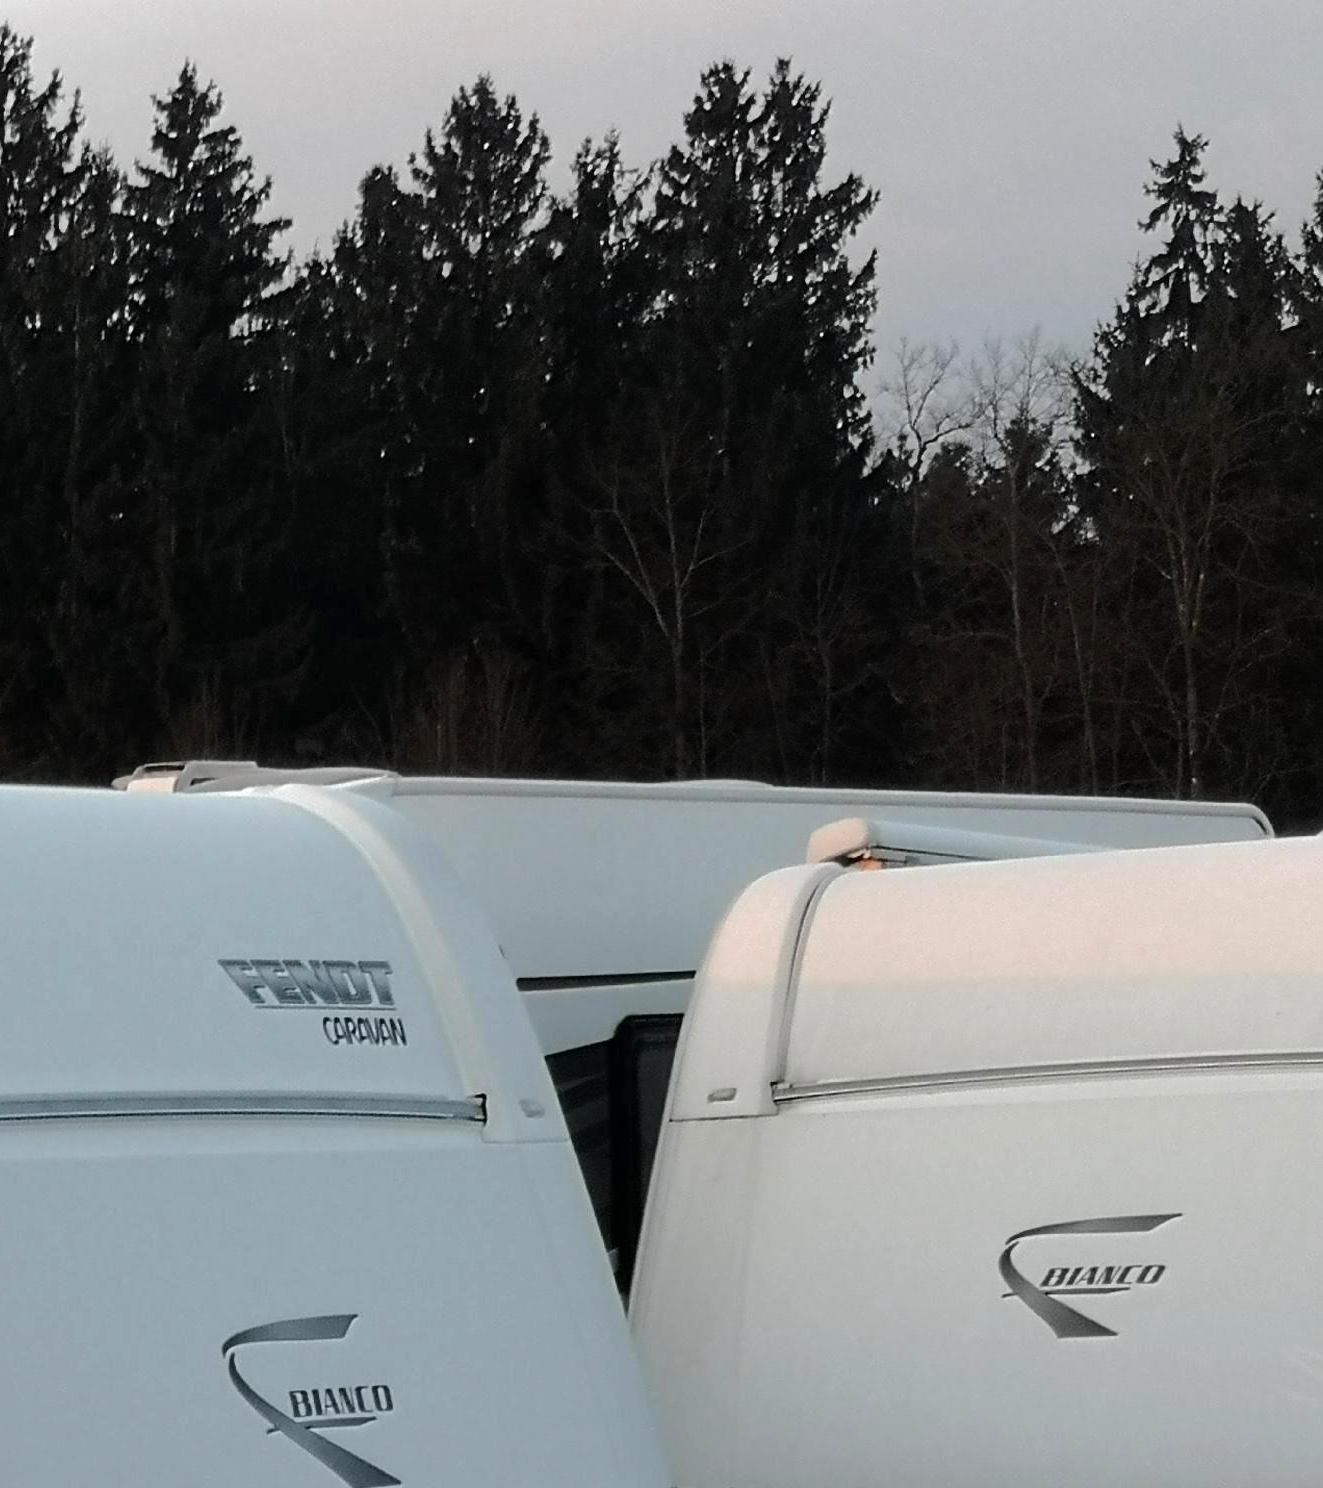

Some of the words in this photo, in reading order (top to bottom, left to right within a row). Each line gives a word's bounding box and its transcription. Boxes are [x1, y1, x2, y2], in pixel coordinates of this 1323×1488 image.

[218, 959, 395, 1005] FENDT
[323, 1017, 408, 1046] CARAVAN
[1039, 1264, 1166, 1287] BIANCO
[289, 1385, 394, 1418] BIANCO
